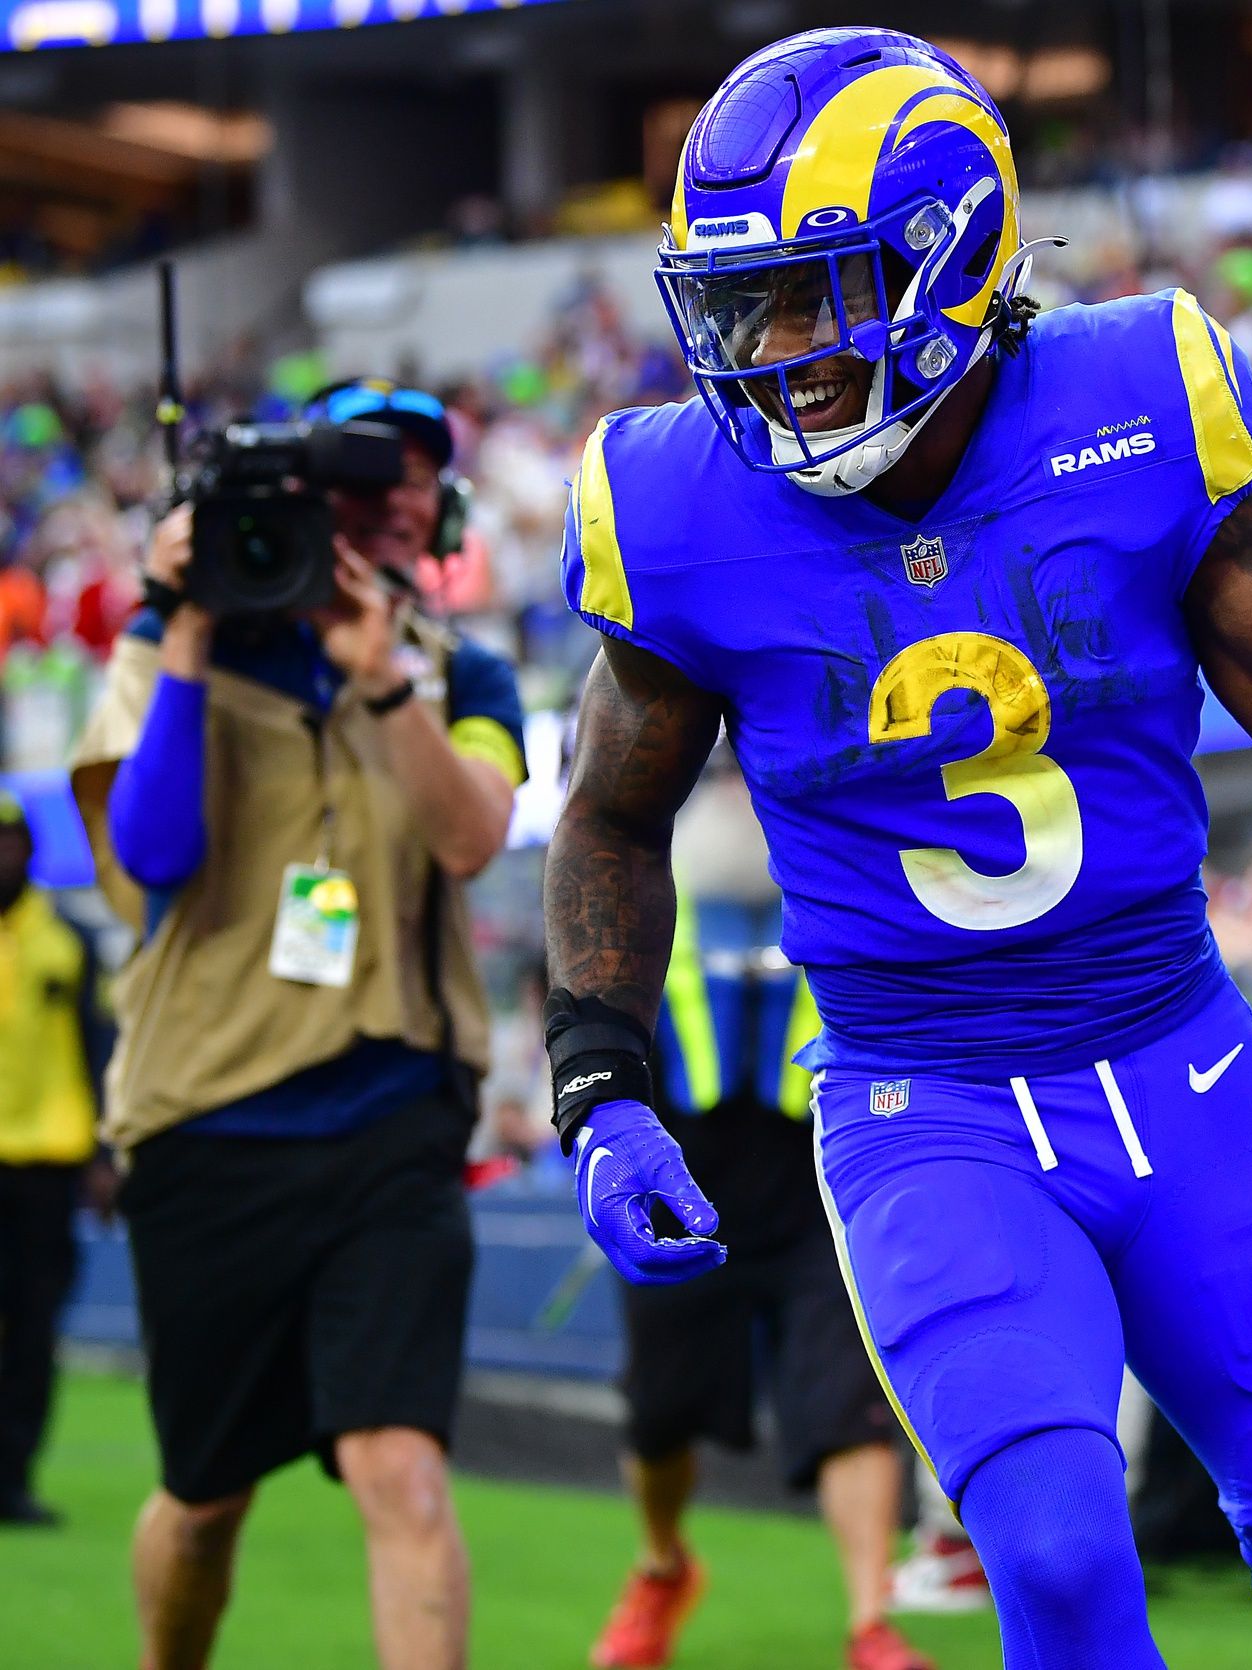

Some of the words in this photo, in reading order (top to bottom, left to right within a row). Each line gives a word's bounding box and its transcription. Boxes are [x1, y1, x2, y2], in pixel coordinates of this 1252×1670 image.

[694, 219, 750, 238] RAMS
[1050, 432, 1156, 477] RAMS
[910, 557, 942, 579] NFL
[868, 631, 1083, 931] 3
[876, 1092, 903, 1109] NFL
